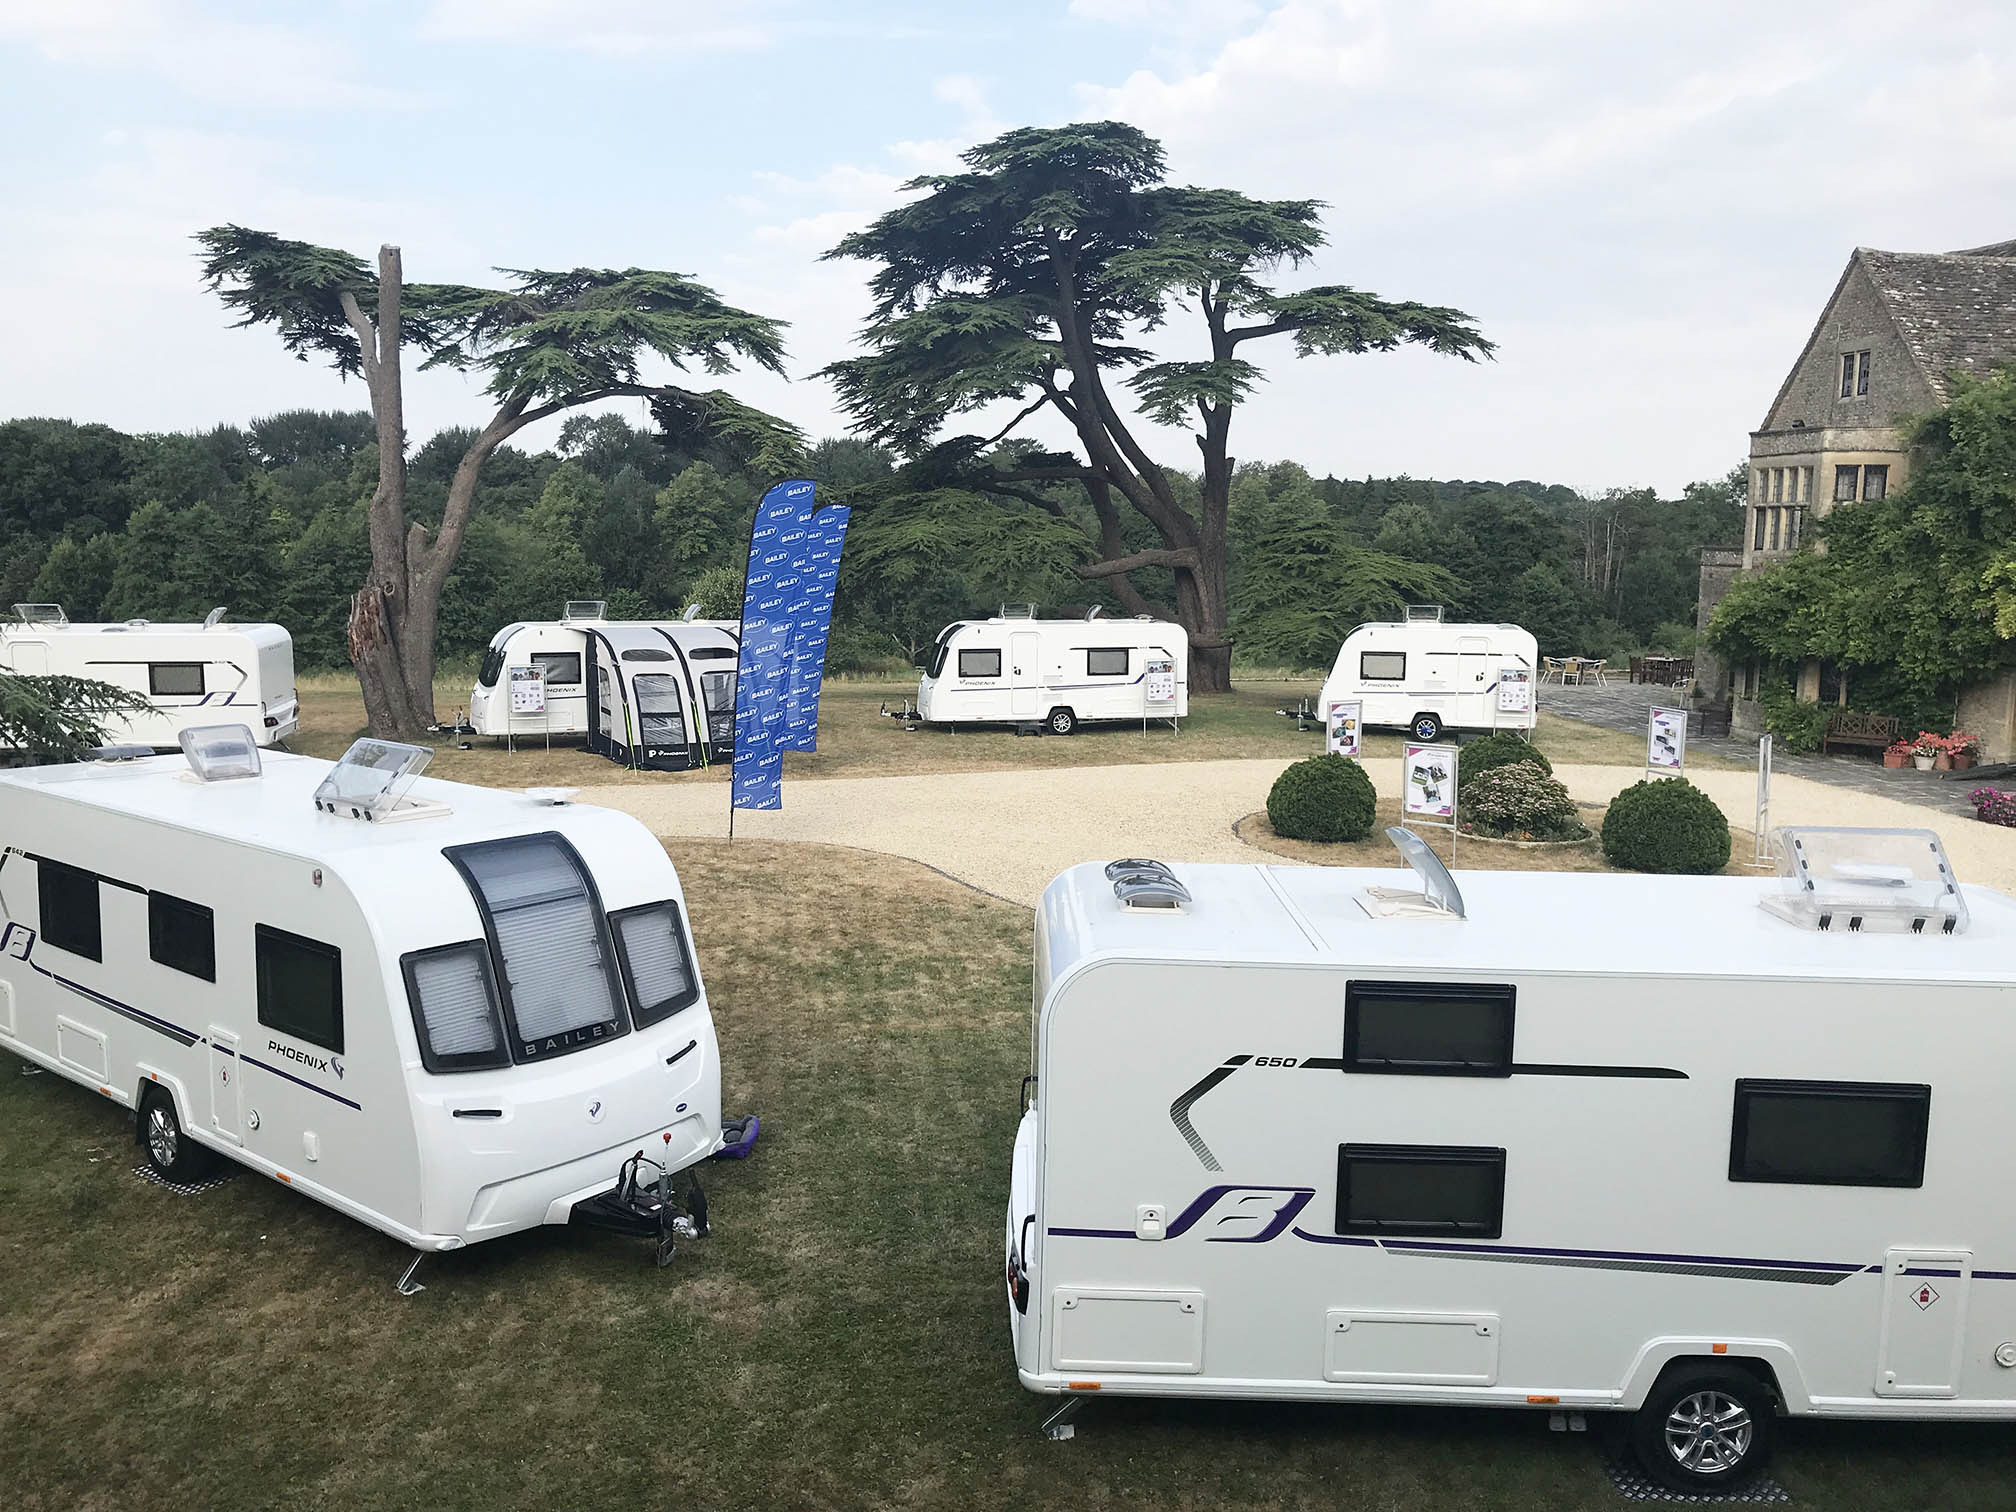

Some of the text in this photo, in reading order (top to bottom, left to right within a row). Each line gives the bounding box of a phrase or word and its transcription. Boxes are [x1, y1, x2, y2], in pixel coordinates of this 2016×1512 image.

[787, 485, 812, 496] BAILEY
[770, 506, 793, 517] BAILEY
[753, 527, 776, 538] BAILEY
[781, 531, 805, 542] BAILEY
[765, 552, 788, 563] BAILEY
[748, 573, 771, 584] BAILEY
[776, 577, 799, 589] BAILEY
[760, 597, 783, 609] BAILEY
[744, 618, 767, 630] BAILEY
[771, 622, 793, 634] BAILEY
[755, 643, 778, 654] BAILEY
[740, 664, 762, 675] BAILEY
[767, 666, 788, 678] BAILEY
[752, 688, 773, 699] BAILEY
[736, 708, 758, 719] BAILEY
[763, 711, 784, 723] BAILEY
[747, 732, 769, 743] BAILEY
[744, 775, 767, 787] BAILEY
[525, 1021, 619, 1056] BAILEY
[268, 1040, 328, 1072] PHOENIX
[1255, 1057, 1298, 1068] 650
